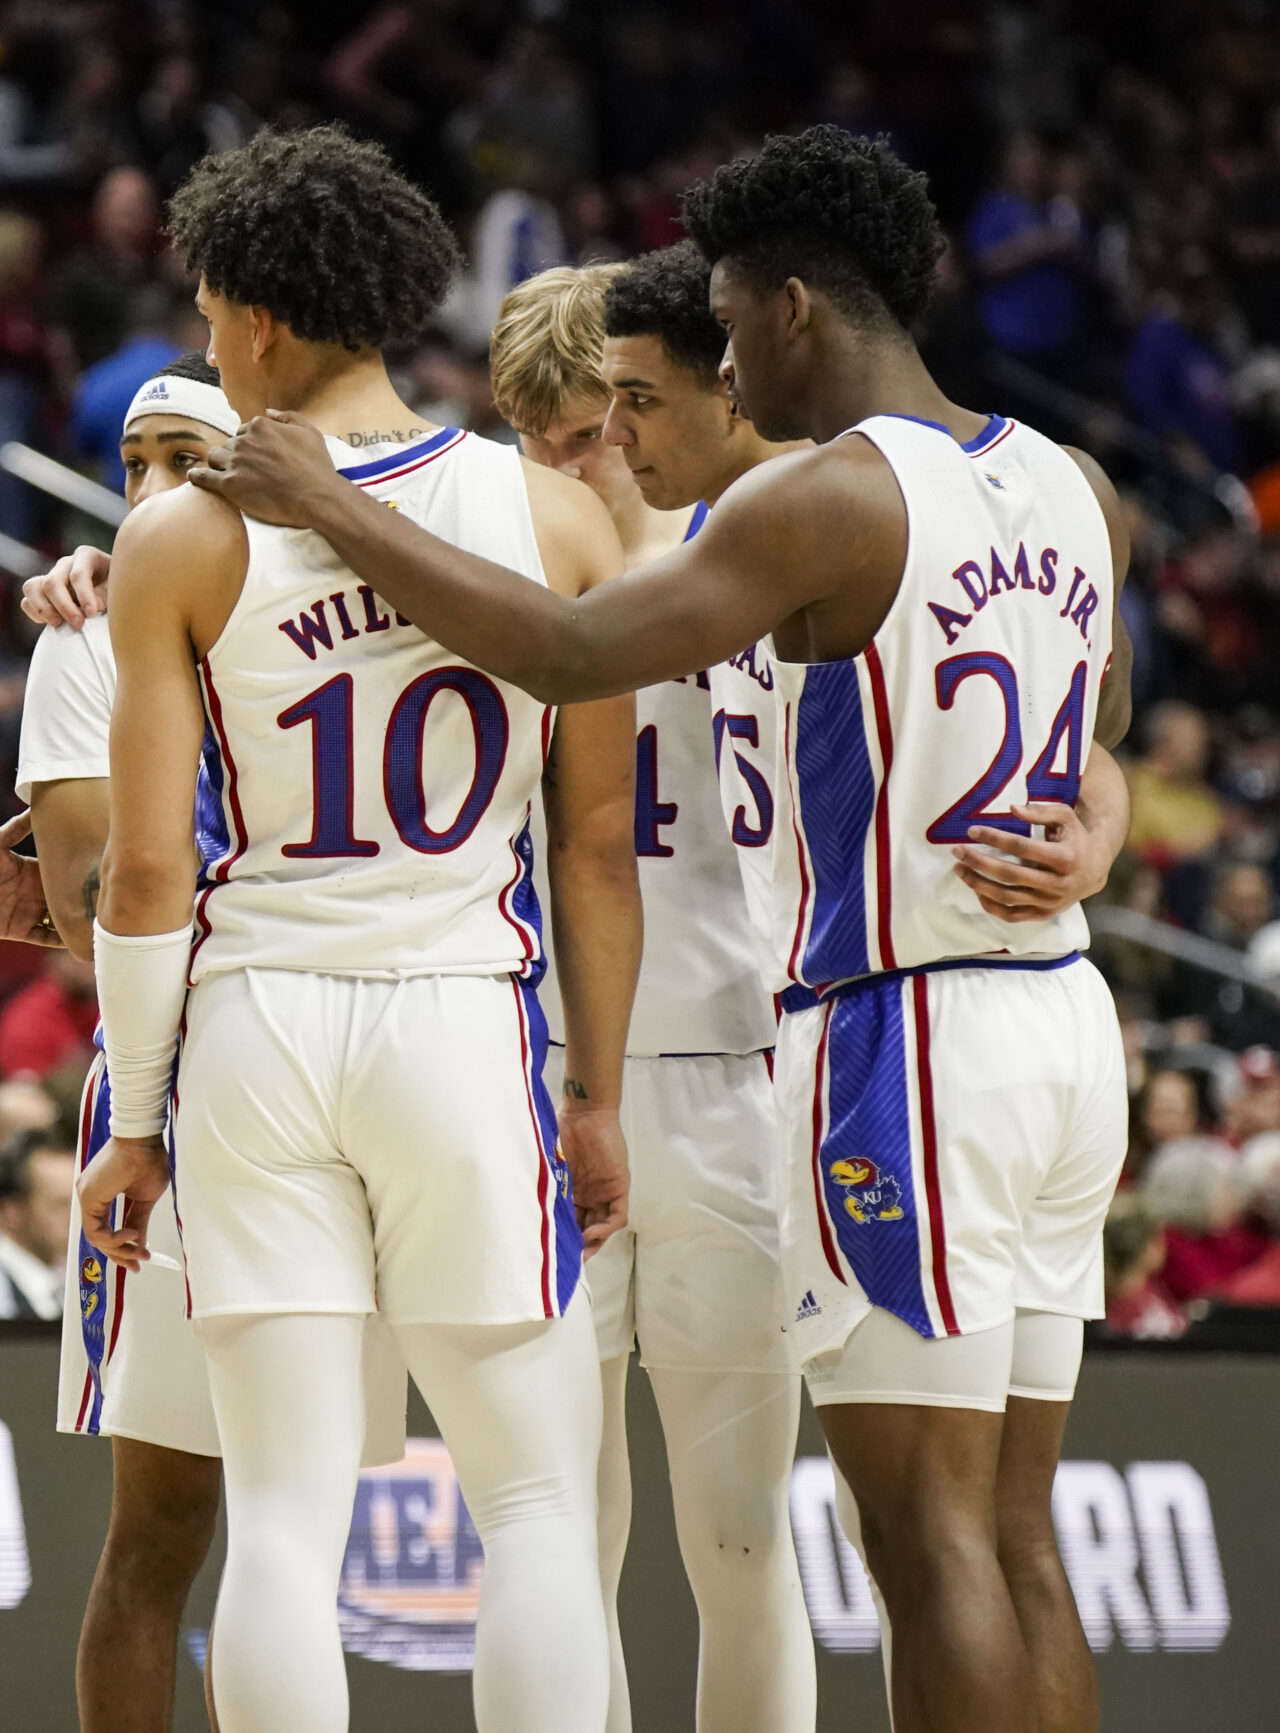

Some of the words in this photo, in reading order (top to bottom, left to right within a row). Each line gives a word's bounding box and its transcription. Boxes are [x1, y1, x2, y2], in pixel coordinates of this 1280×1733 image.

[277, 666, 509, 857] 10
[926, 651, 1087, 844] 24
[863, 1191, 883, 1203] KU
